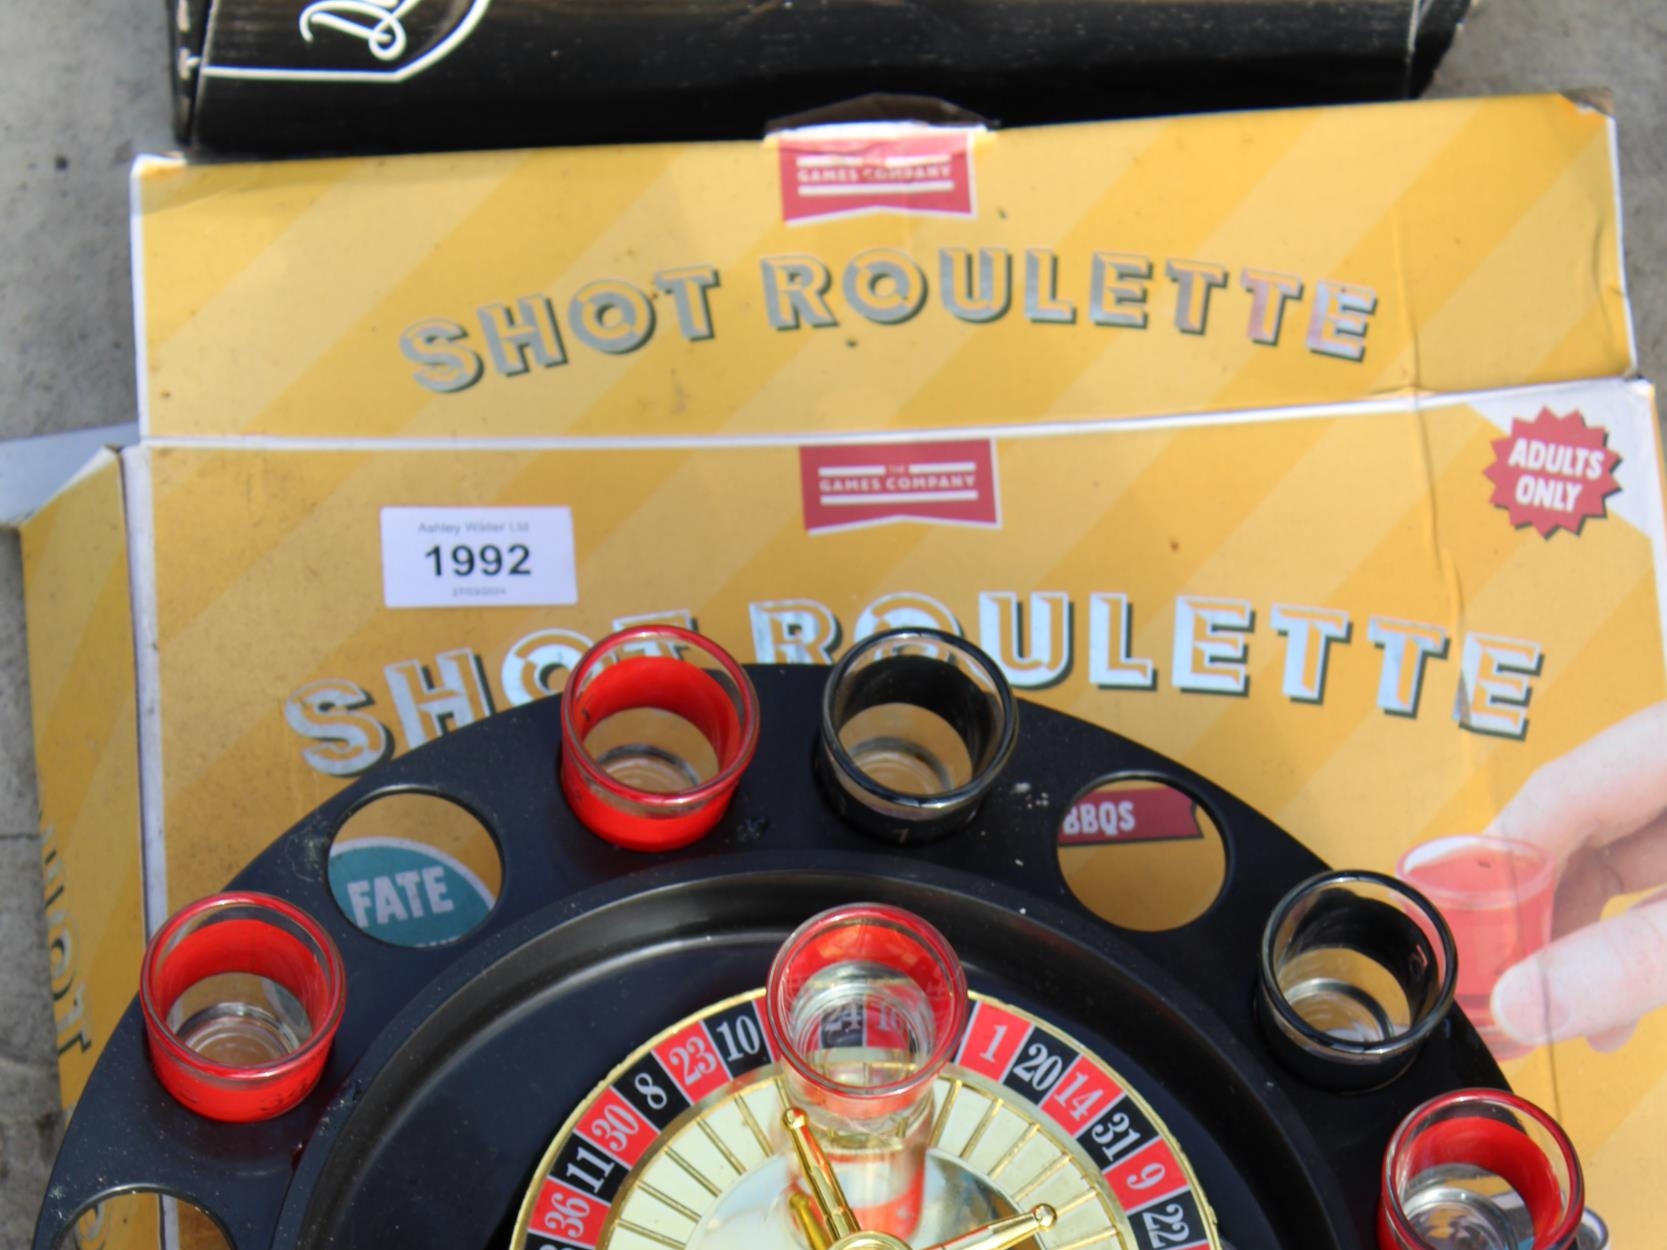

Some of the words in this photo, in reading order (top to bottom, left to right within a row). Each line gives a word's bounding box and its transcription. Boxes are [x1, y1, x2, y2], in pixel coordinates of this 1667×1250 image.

[797, 167, 859, 183] GAMES
[401, 265, 720, 393] SHOT
[761, 247, 1377, 363] ROULETTE
[1507, 437, 1604, 480] ADULTS
[818, 478, 880, 492] GAMES
[884, 475, 976, 491] COMPANY
[1515, 474, 1582, 512] ONLY
[425, 543, 532, 577] 1992
[1062, 800, 1136, 836] BBQS
[346, 865, 455, 929] FATE
[669, 1037, 717, 1086] 23
[716, 1015, 761, 1062] 10
[979, 1023, 1008, 1064] 1
[634, 1071, 668, 1110] 8
[1013, 1042, 1064, 1092] 20
[1053, 1070, 1105, 1121] 14
[591, 1103, 640, 1153] 30
[1091, 1111, 1142, 1162] 31
[565, 1146, 615, 1194] 11
[1126, 1161, 1167, 1192] 9
[543, 1191, 591, 1239] 36
[1142, 1203, 1190, 1250] 22
